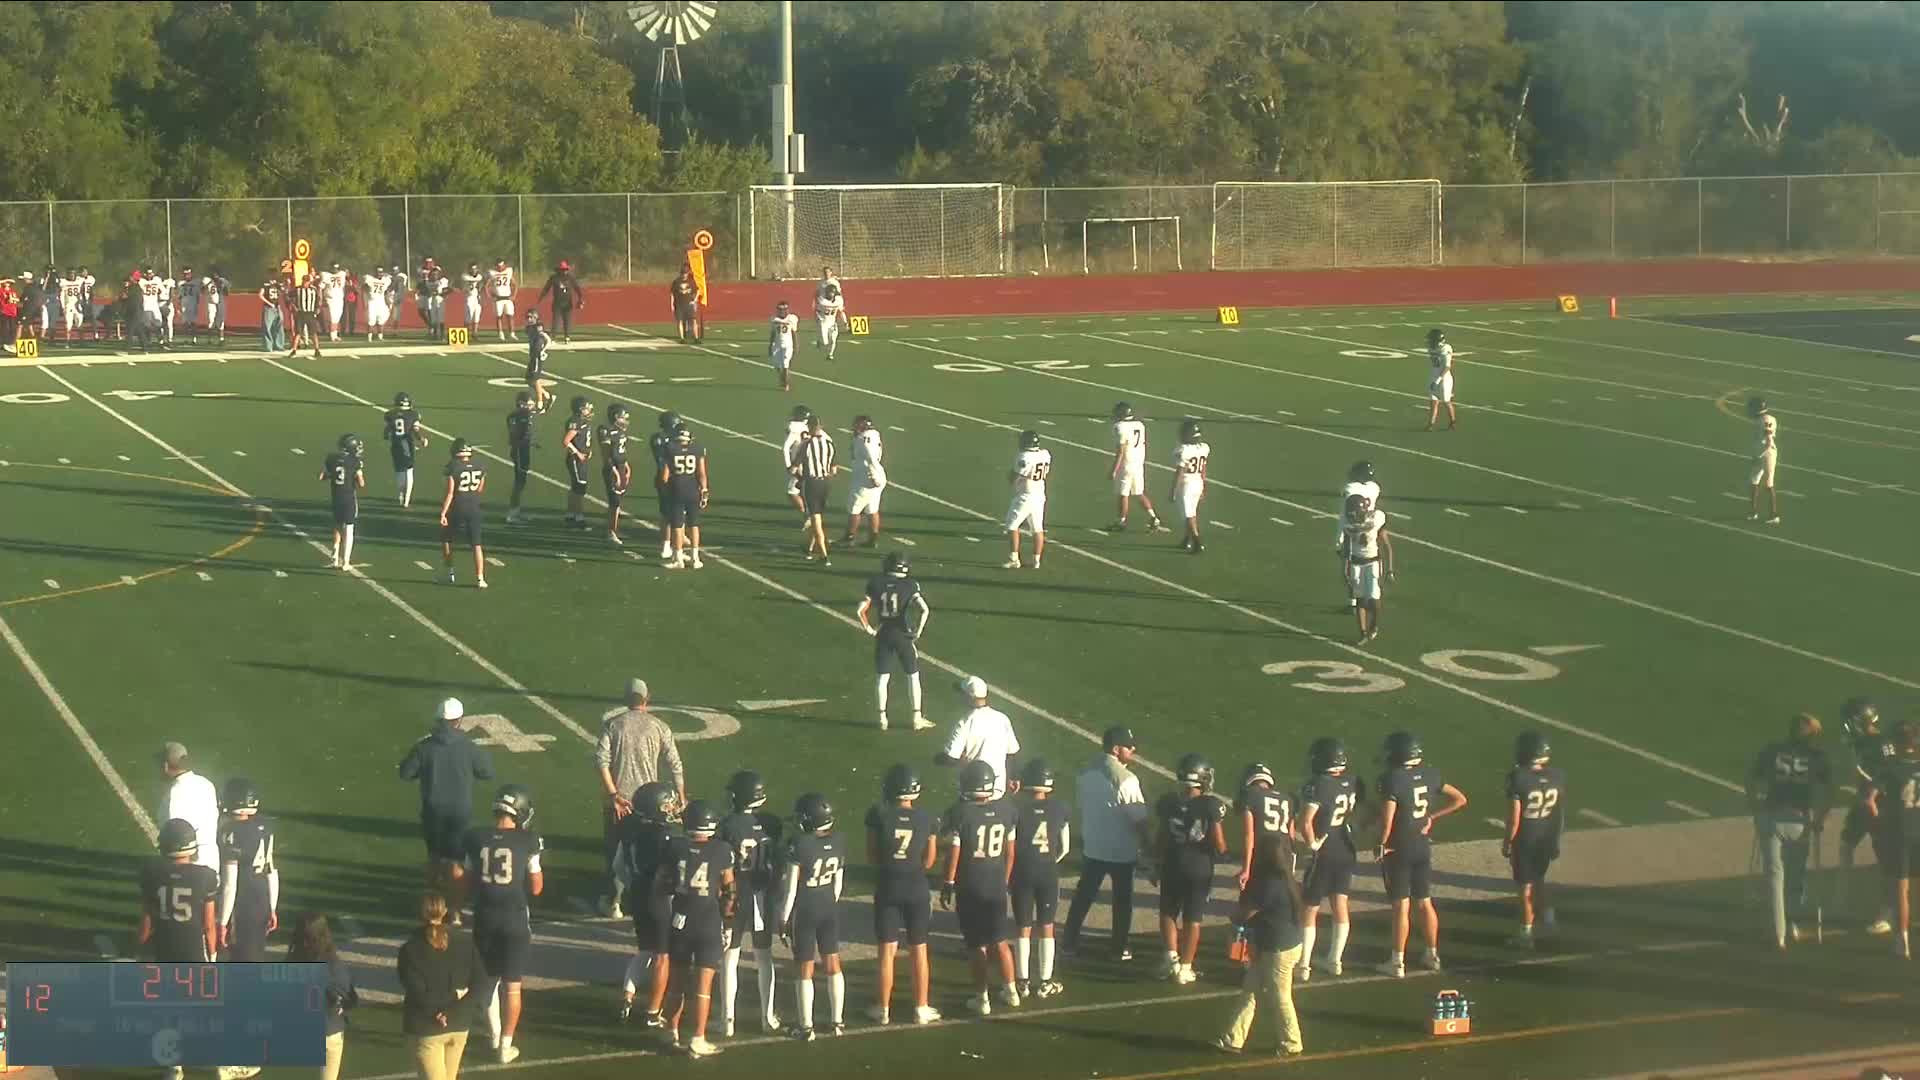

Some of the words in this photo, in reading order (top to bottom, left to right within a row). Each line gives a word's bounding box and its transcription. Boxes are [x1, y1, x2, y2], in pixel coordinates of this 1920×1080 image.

[853, 318, 867, 332] 20
[1222, 308, 1236, 322] 10
[19, 340, 35, 356] 40
[450, 329, 466, 344] 30
[395, 418, 406, 436] 9
[1133, 429, 1141, 448] 7
[335, 465, 345, 485] 3
[674, 454, 697, 475] 59
[458, 470, 482, 492] 25
[880, 591, 900, 617] 11
[1413, 785, 1429, 819] 5
[1525, 788, 1559, 819] 22
[1263, 796, 1289, 834] 51
[893, 828, 913, 860] 7
[973, 823, 1005, 858] 18
[1032, 821, 1050, 854] 4
[479, 845, 512, 885] 13
[806, 856, 839, 888] 12
[157, 885, 192, 922] 15
[1446, 1021, 1457, 1032] G
